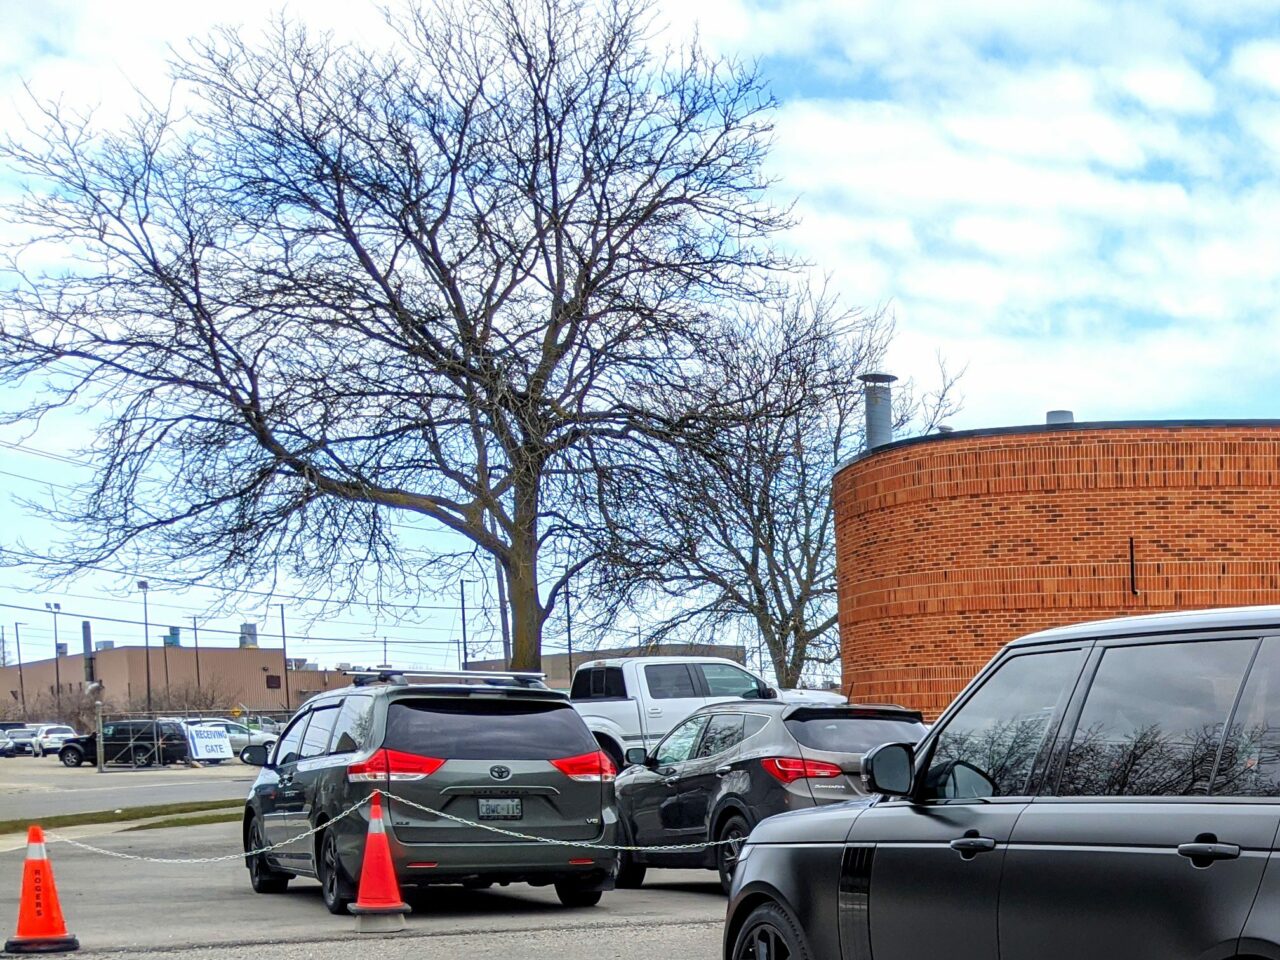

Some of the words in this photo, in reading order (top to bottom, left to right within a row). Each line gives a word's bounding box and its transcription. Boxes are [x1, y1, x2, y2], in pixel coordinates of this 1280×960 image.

[195, 730, 227, 739] RECEIVING
[205, 744, 225, 753] GATE
[34, 869, 43, 917] ROGERS
